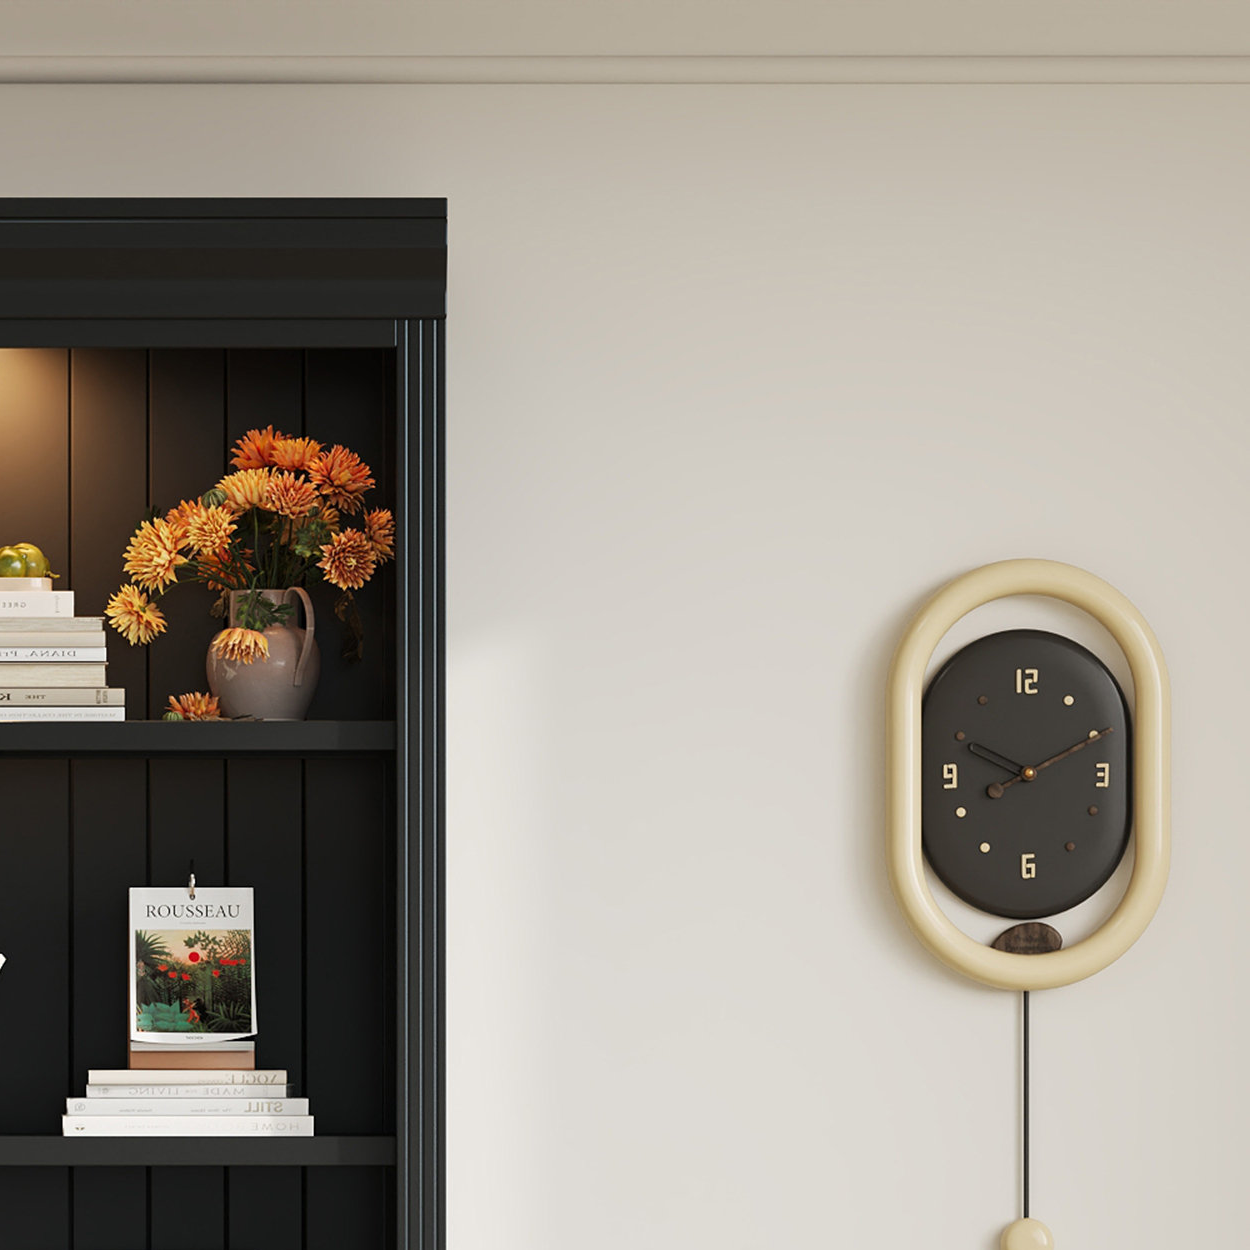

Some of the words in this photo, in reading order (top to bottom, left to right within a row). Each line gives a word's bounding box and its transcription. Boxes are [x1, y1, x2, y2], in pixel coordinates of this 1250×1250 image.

[1016, 669, 1038, 694] 12
[943, 763, 958, 789] 9
[1095, 763, 1109, 788] 3
[1021, 853, 1036, 879] 6
[146, 905, 240, 918] ROUSSEAU
